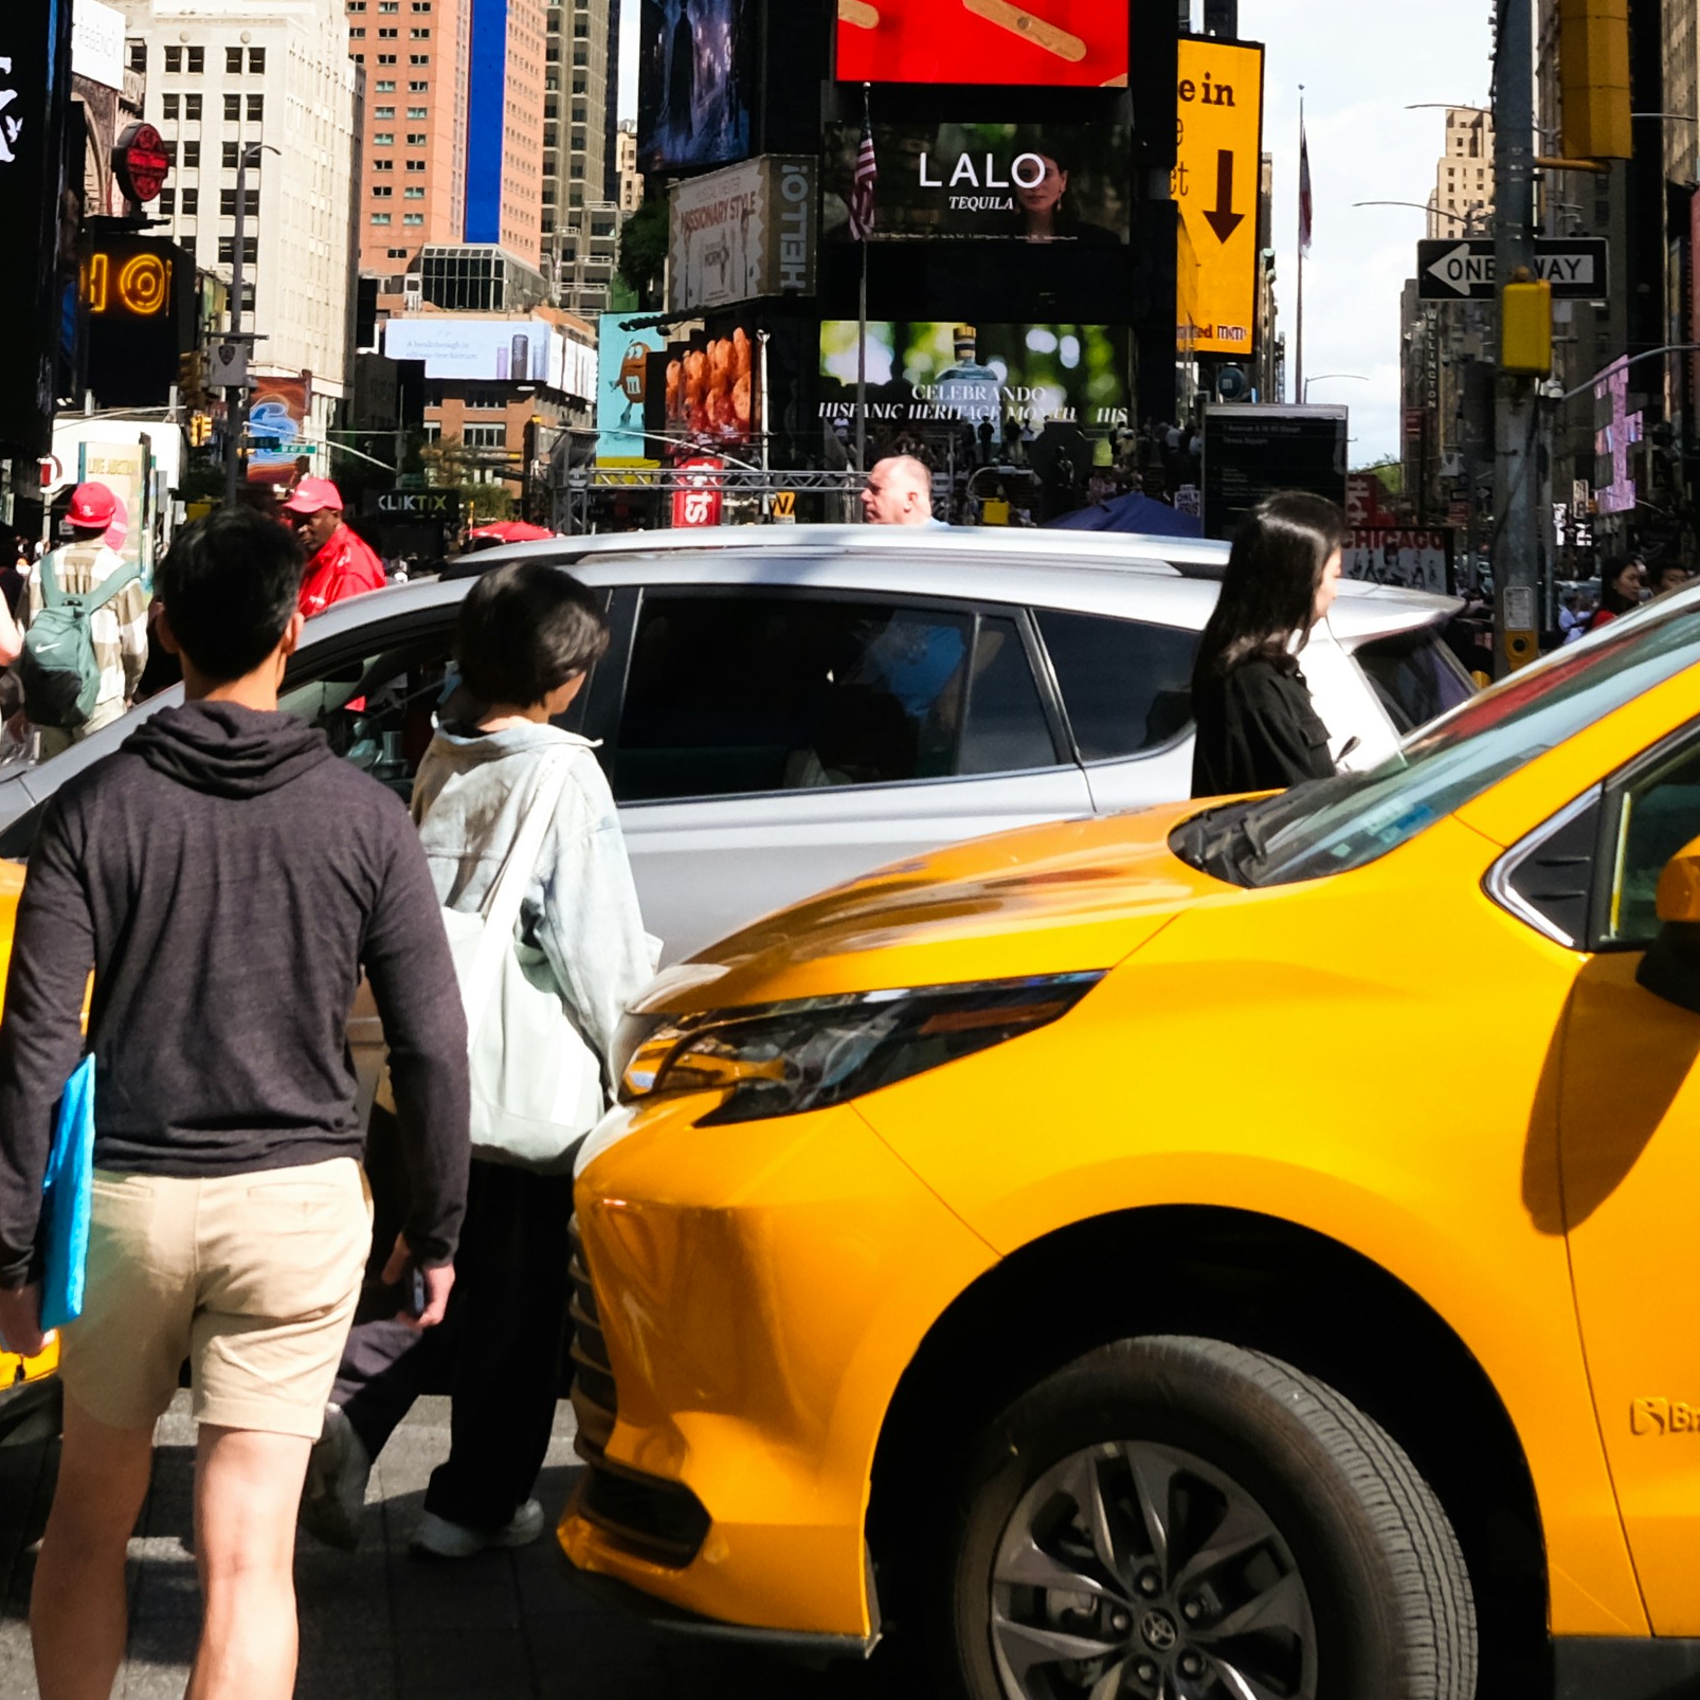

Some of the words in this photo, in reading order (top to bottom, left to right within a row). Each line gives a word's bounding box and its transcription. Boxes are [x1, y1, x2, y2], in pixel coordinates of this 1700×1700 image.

[1201, 72, 1236, 107] in
[918, 151, 1047, 189] LALO
[948, 195, 1015, 212] TEQUILA
[779, 163, 810, 290] HELLO!
[1446, 257, 1496, 283] ONE
[1425, 311, 1438, 409] WELLINGTON
[911, 383, 1049, 403] CELEBRANDO
[908, 402, 1004, 422] HERITAGE
[1341, 530, 1446, 550] CHICAGO
